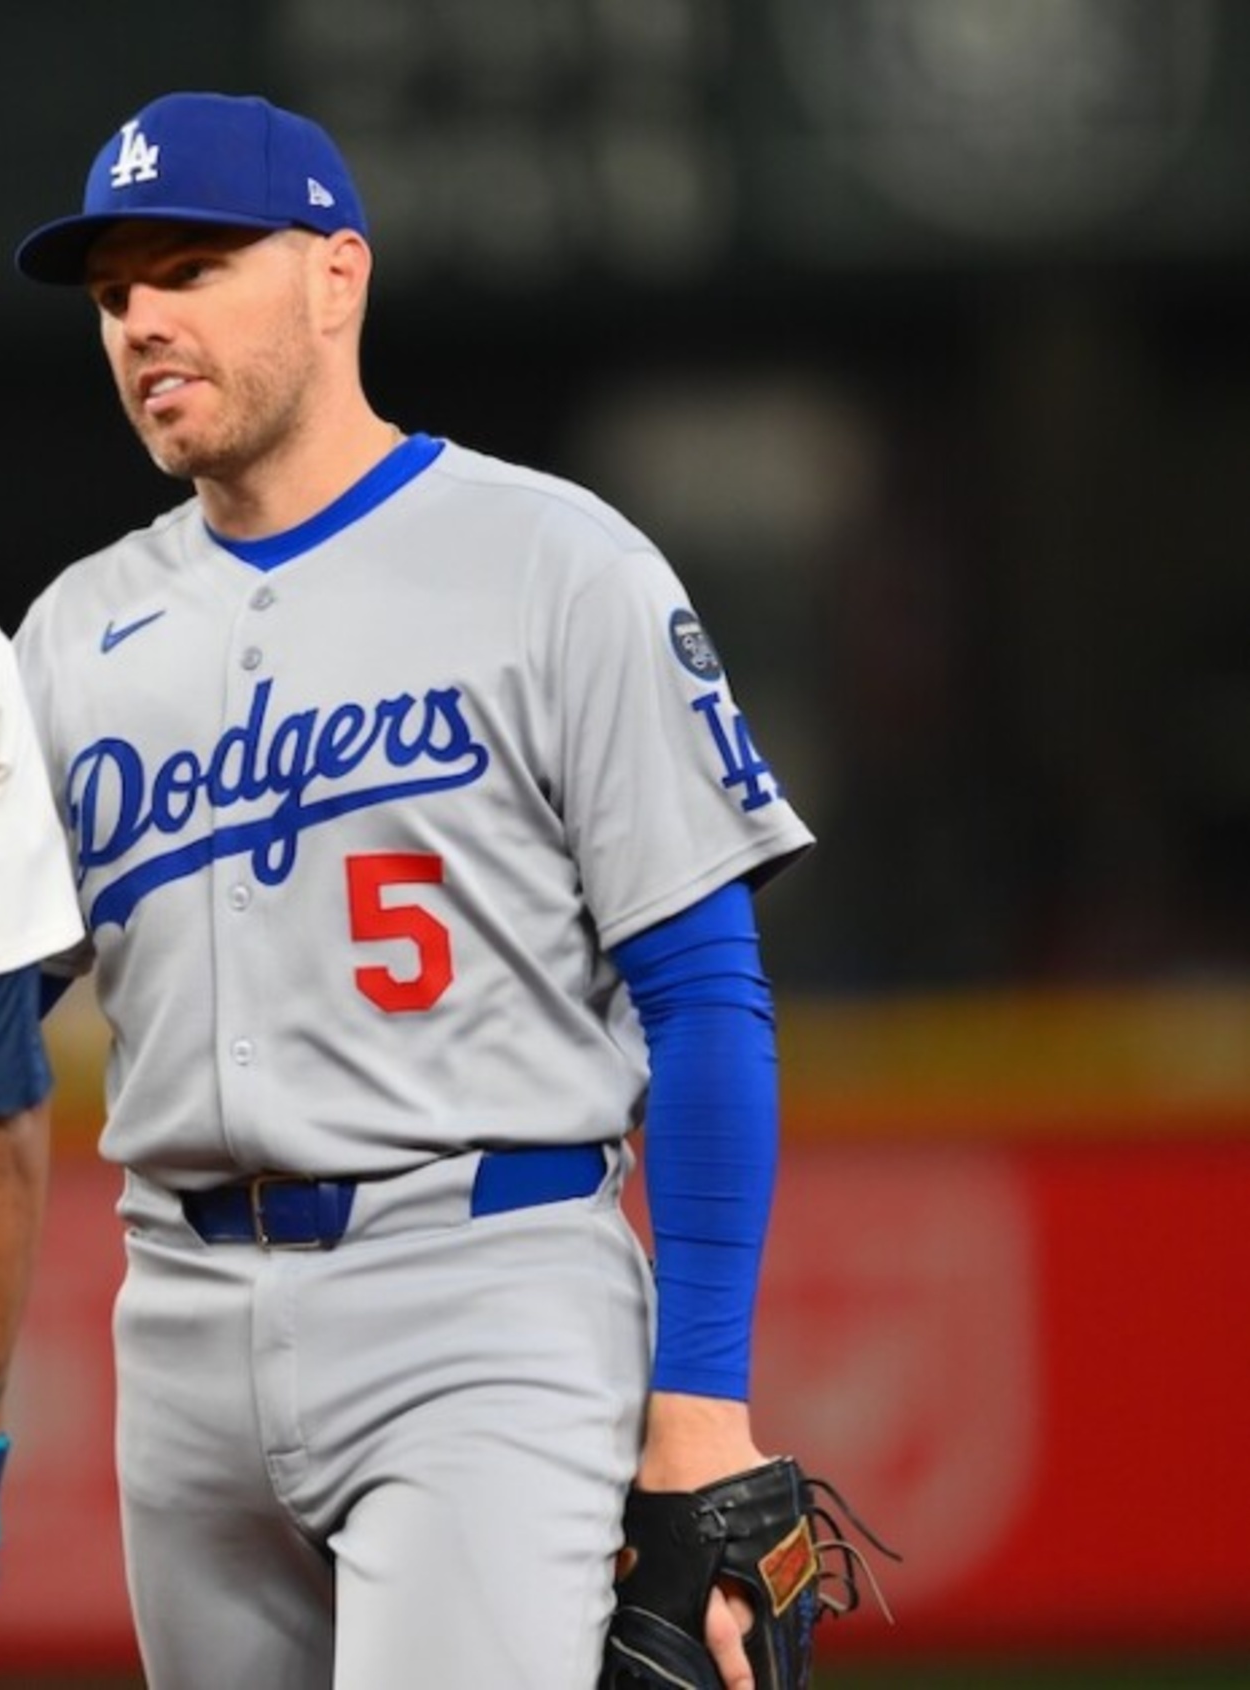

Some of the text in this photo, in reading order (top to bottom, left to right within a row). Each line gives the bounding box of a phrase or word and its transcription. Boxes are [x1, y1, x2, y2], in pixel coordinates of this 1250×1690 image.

[110, 119, 159, 188] LA
[66, 677, 489, 888] Dodgers
[345, 853, 454, 1014] 5
